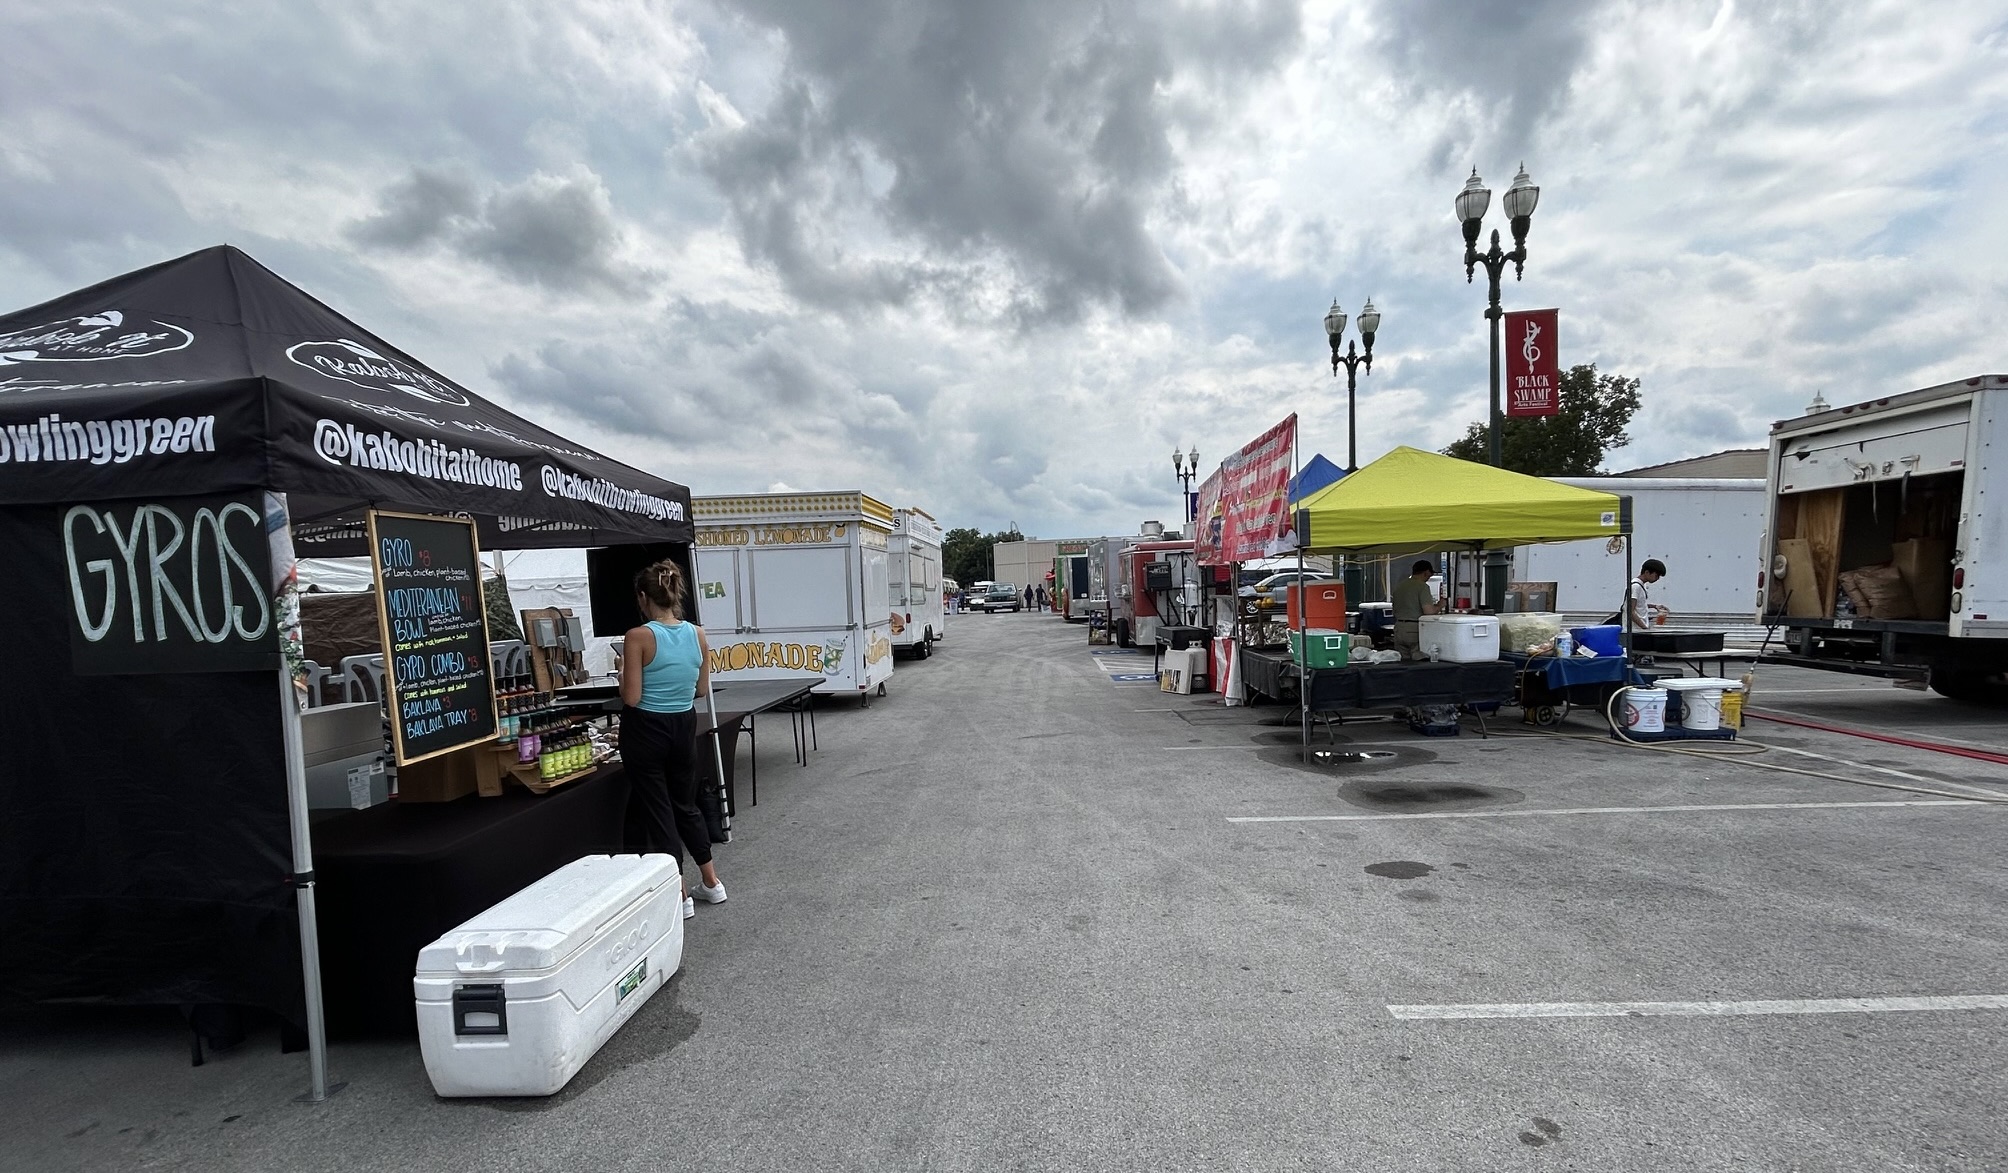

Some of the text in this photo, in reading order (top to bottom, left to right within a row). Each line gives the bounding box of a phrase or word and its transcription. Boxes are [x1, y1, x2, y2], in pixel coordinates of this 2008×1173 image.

[1514, 388, 1551, 403] SWAMP
[1515, 375, 1549, 388] BLACK
[314, 418, 522, 491] @kabobitathome
[541, 464, 684, 521] @kabobitbowlinggreen
[754, 527, 831, 545] LEMONADE
[382, 538, 412, 567] GYRO
[64, 502, 269, 643] GYROS
[388, 587, 460, 618] MEDITERANEAN
[394, 618, 428, 641] BOWL
[396, 654, 426, 681] GYRO
[431, 652, 465, 676] COMBO
[709, 642, 823, 673] MONADE
[403, 698, 441, 719] BAKLAVA
[406, 715, 444, 739] BAKLAVA
[444, 709, 467, 726] TRAY
